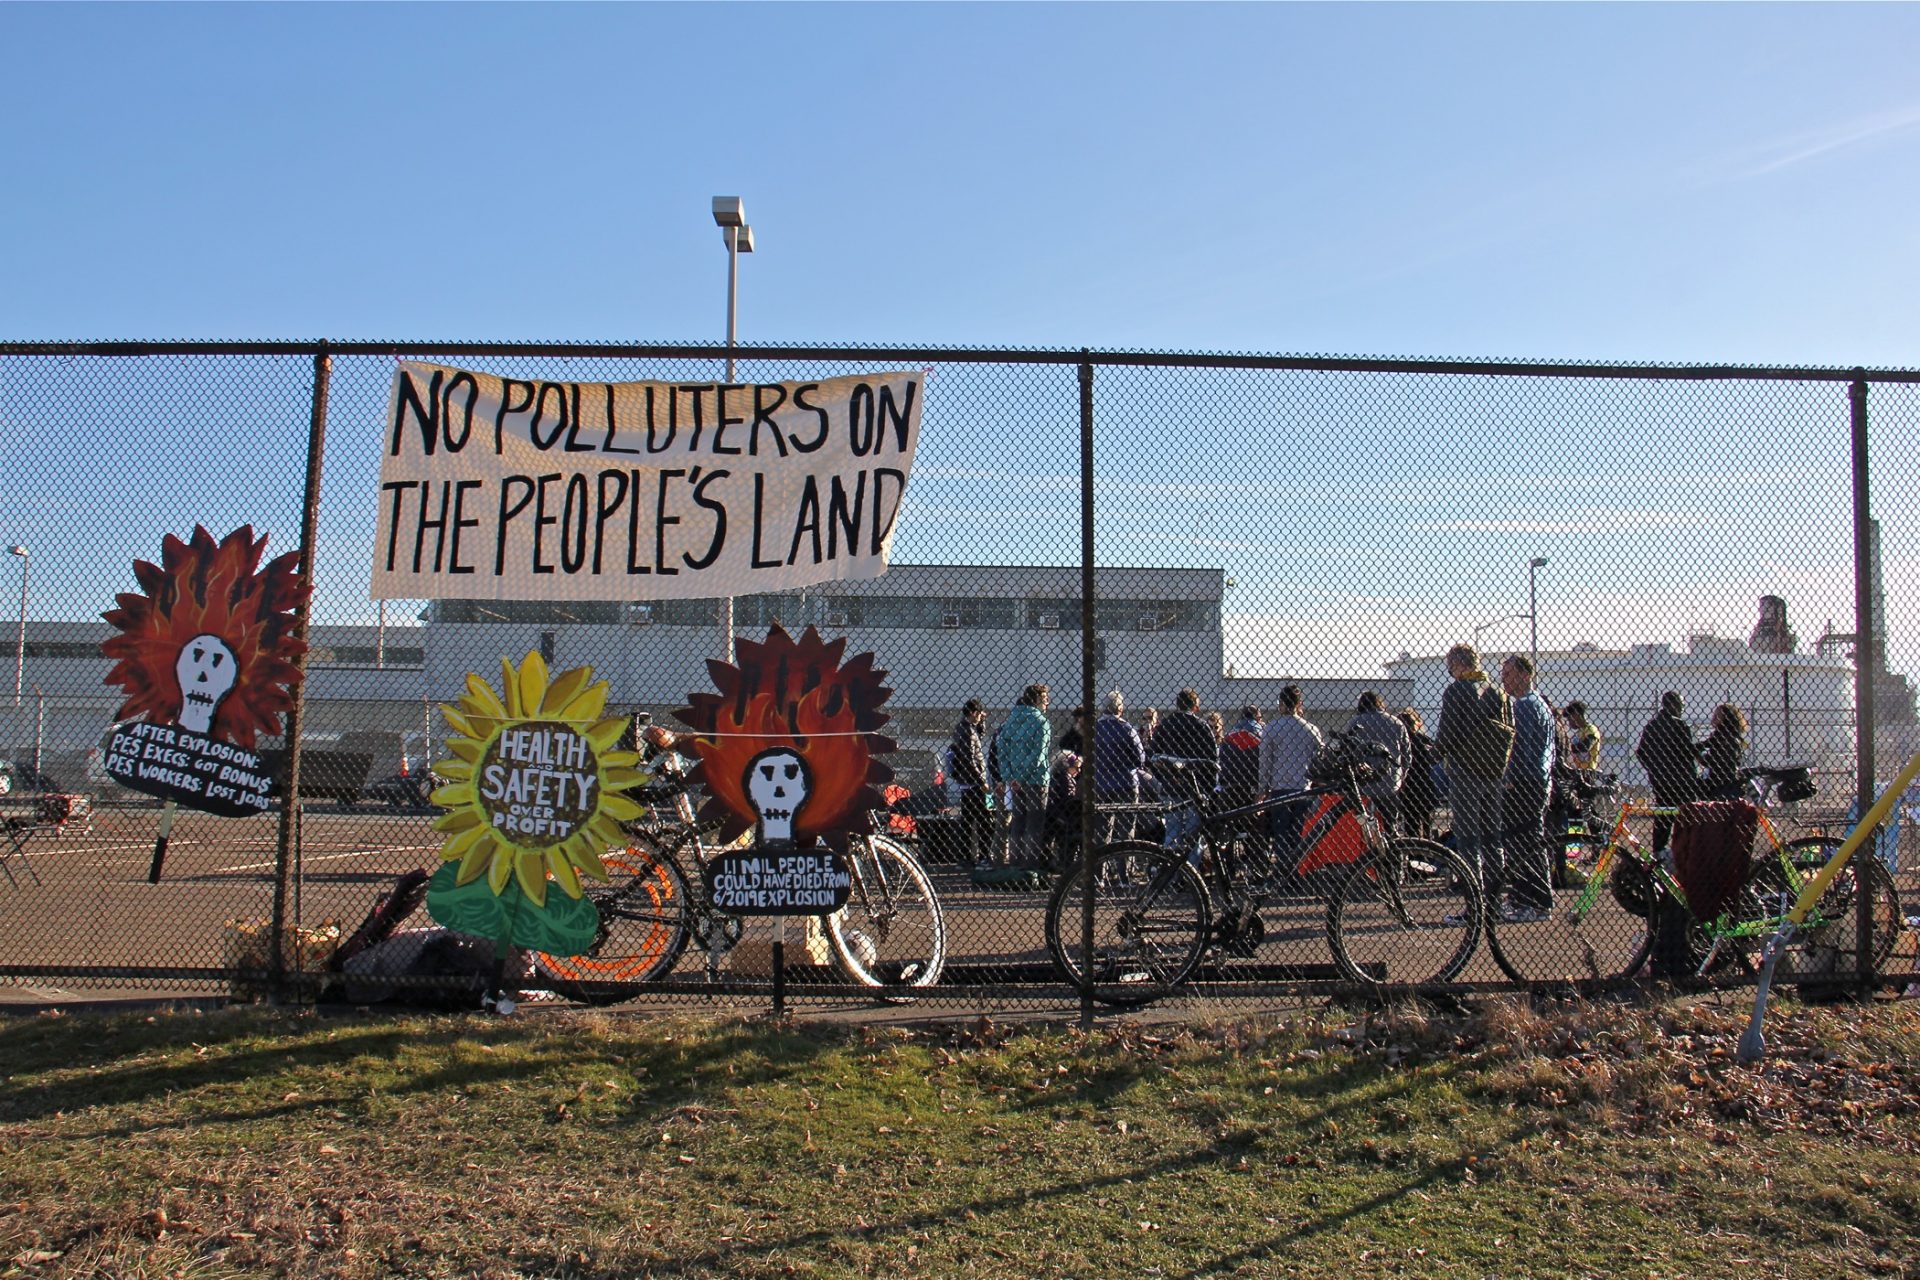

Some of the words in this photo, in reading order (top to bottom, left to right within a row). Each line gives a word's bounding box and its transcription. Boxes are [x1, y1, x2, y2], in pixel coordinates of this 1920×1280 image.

[391, 369, 479, 456] NO
[495, 379, 829, 457] POLLUTERS
[848, 381, 917, 457] ON
[382, 479, 482, 574] THE
[495, 465, 732, 576] PEOPLE'S
[750, 468, 906, 569] LAND
[130, 723, 176, 744] AFTER
[178, 734, 261, 769] EXPLOSION:
[143, 743, 191, 767] EXECS:
[194, 759, 220, 773] GOT
[500, 729, 588, 769] HEALTH
[138, 761, 203, 792] WORKERS:
[528, 763, 554, 771] AND
[481, 764, 596, 811] SAFETY
[493, 812, 571, 837] PROFIT
[510, 804, 555, 819] OVER
[741, 858, 776, 874] MIL
[778, 855, 833, 874] PEOPLE
[713, 874, 761, 890] COULD
[763, 873, 792, 889] HAVE
[793, 873, 823, 889] DIED
[823, 872, 850, 888] FROM
[758, 889, 835, 907] EXPLOSION
